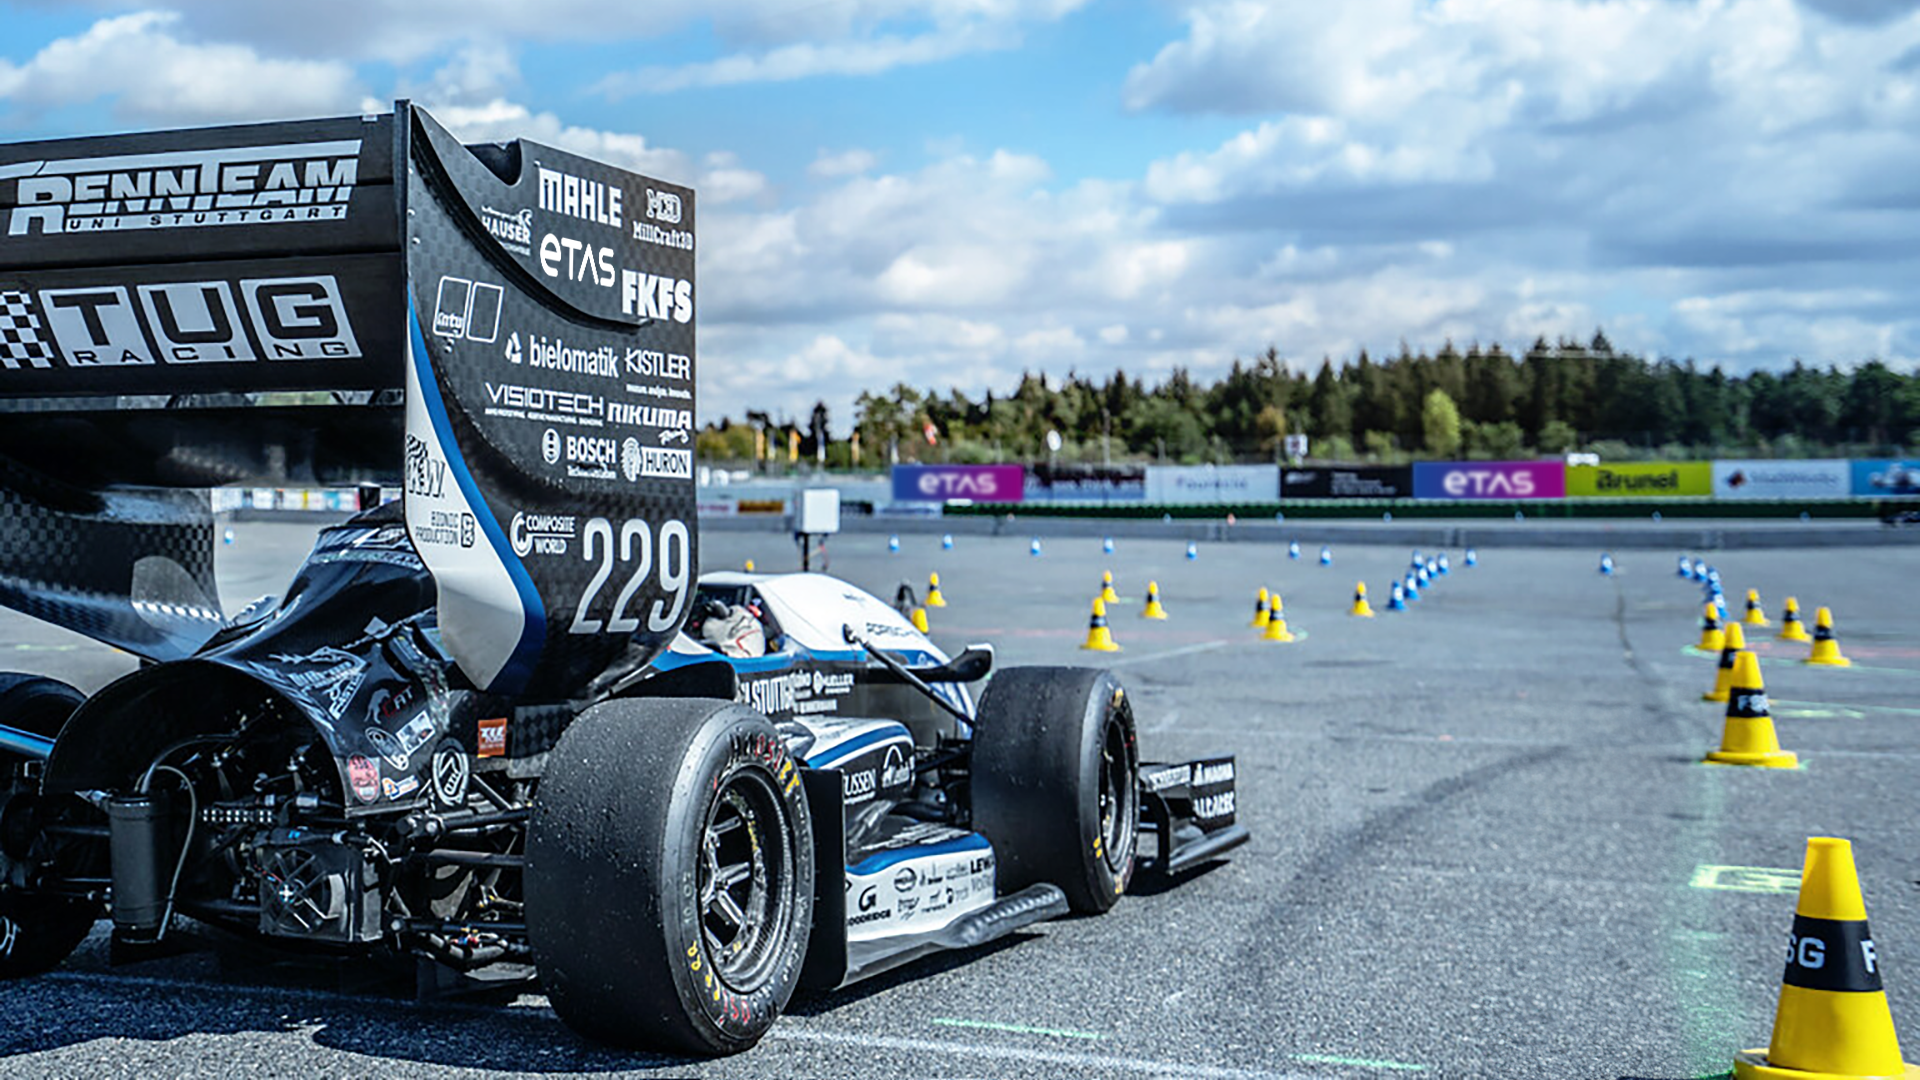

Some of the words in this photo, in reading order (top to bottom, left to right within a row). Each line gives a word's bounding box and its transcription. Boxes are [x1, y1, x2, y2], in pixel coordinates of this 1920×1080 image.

[538, 167, 622, 228] MAHLE
[69, 216, 121, 230] UNI
[150, 206, 346, 226] STUTTGART
[482, 216, 531, 244] HAUSER
[622, 269, 692, 323] FKFS
[50, 282, 339, 347] TUG
[76, 342, 349, 364] RACING
[530, 335, 619, 378] bielomatik
[625, 347, 691, 381] KISTLER
[485, 382, 604, 415] VISIOTECH
[566, 436, 616, 464] BOSCH
[645, 452, 689, 475] HURON
[526, 514, 575, 532] COMPOSITE
[568, 517, 690, 634] 229
